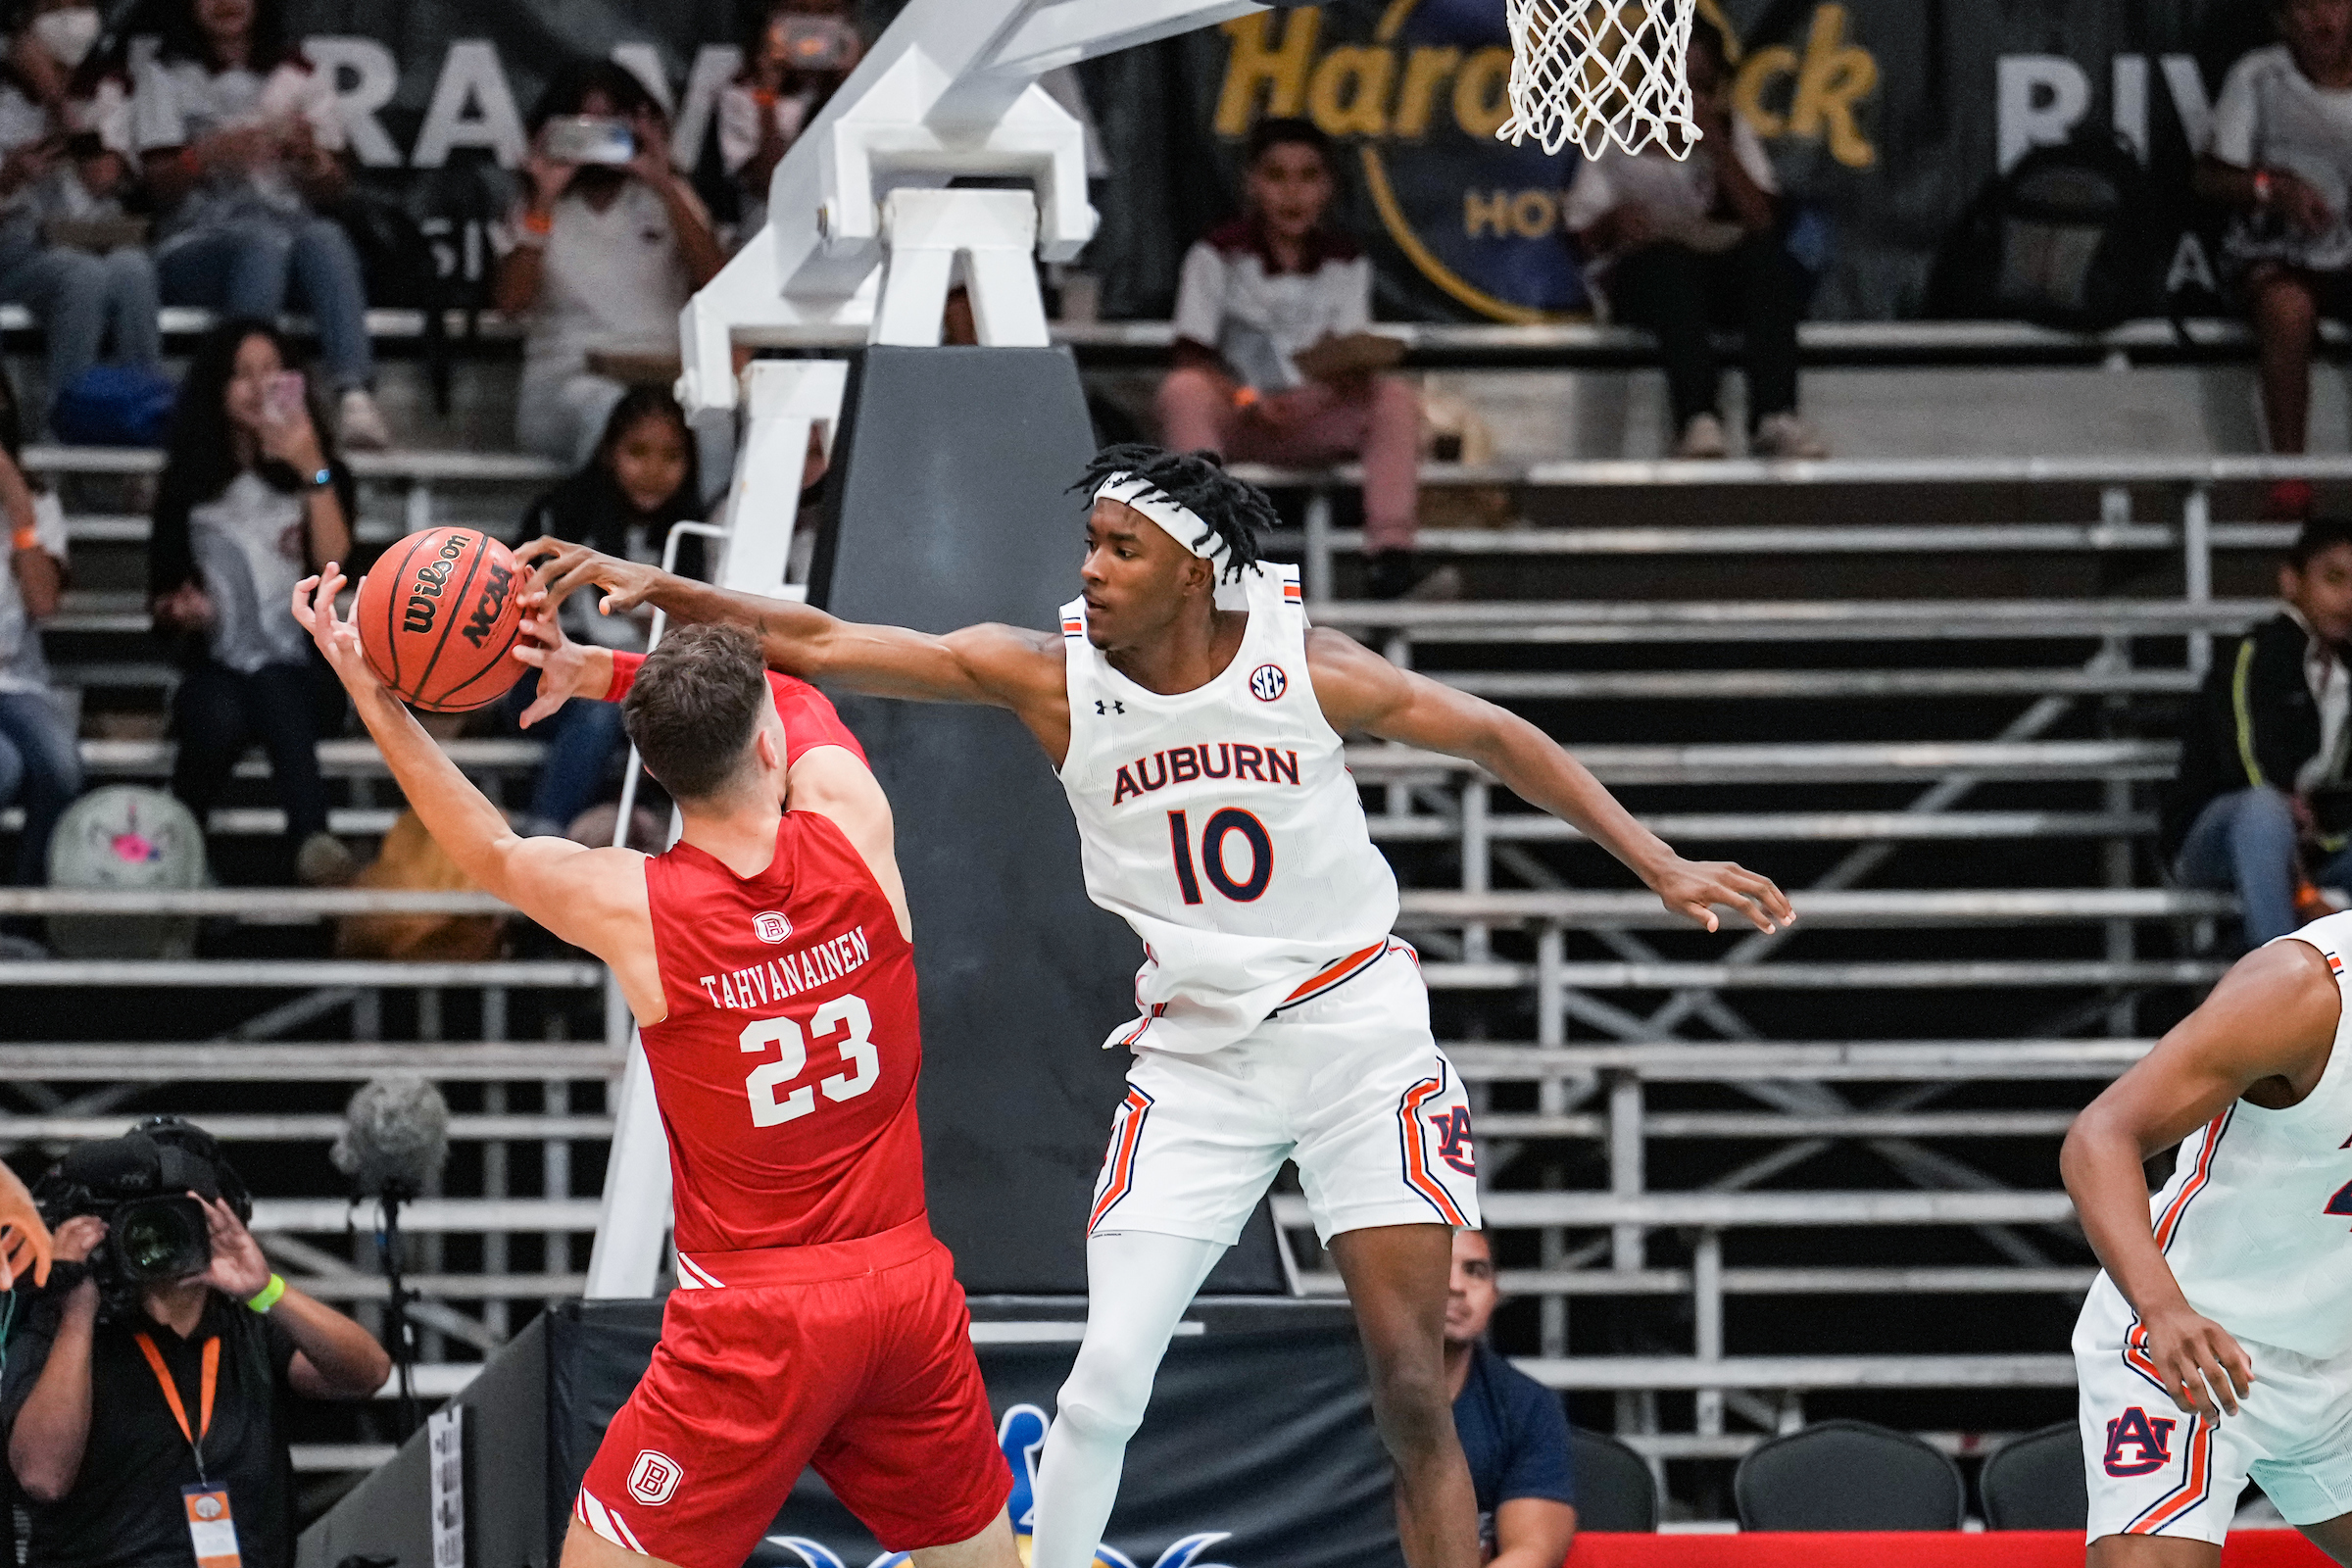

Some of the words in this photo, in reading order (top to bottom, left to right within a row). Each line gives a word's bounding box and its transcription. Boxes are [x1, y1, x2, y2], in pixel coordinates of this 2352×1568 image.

[403, 533, 471, 634] Wilson
[462, 564, 513, 649] NCAA
[1250, 665, 1286, 700] SEC
[1112, 743, 1300, 806] AUBURN
[1167, 807, 1273, 905] 10
[700, 925, 870, 1008] TAHVANAINEN
[739, 994, 880, 1127] 23
